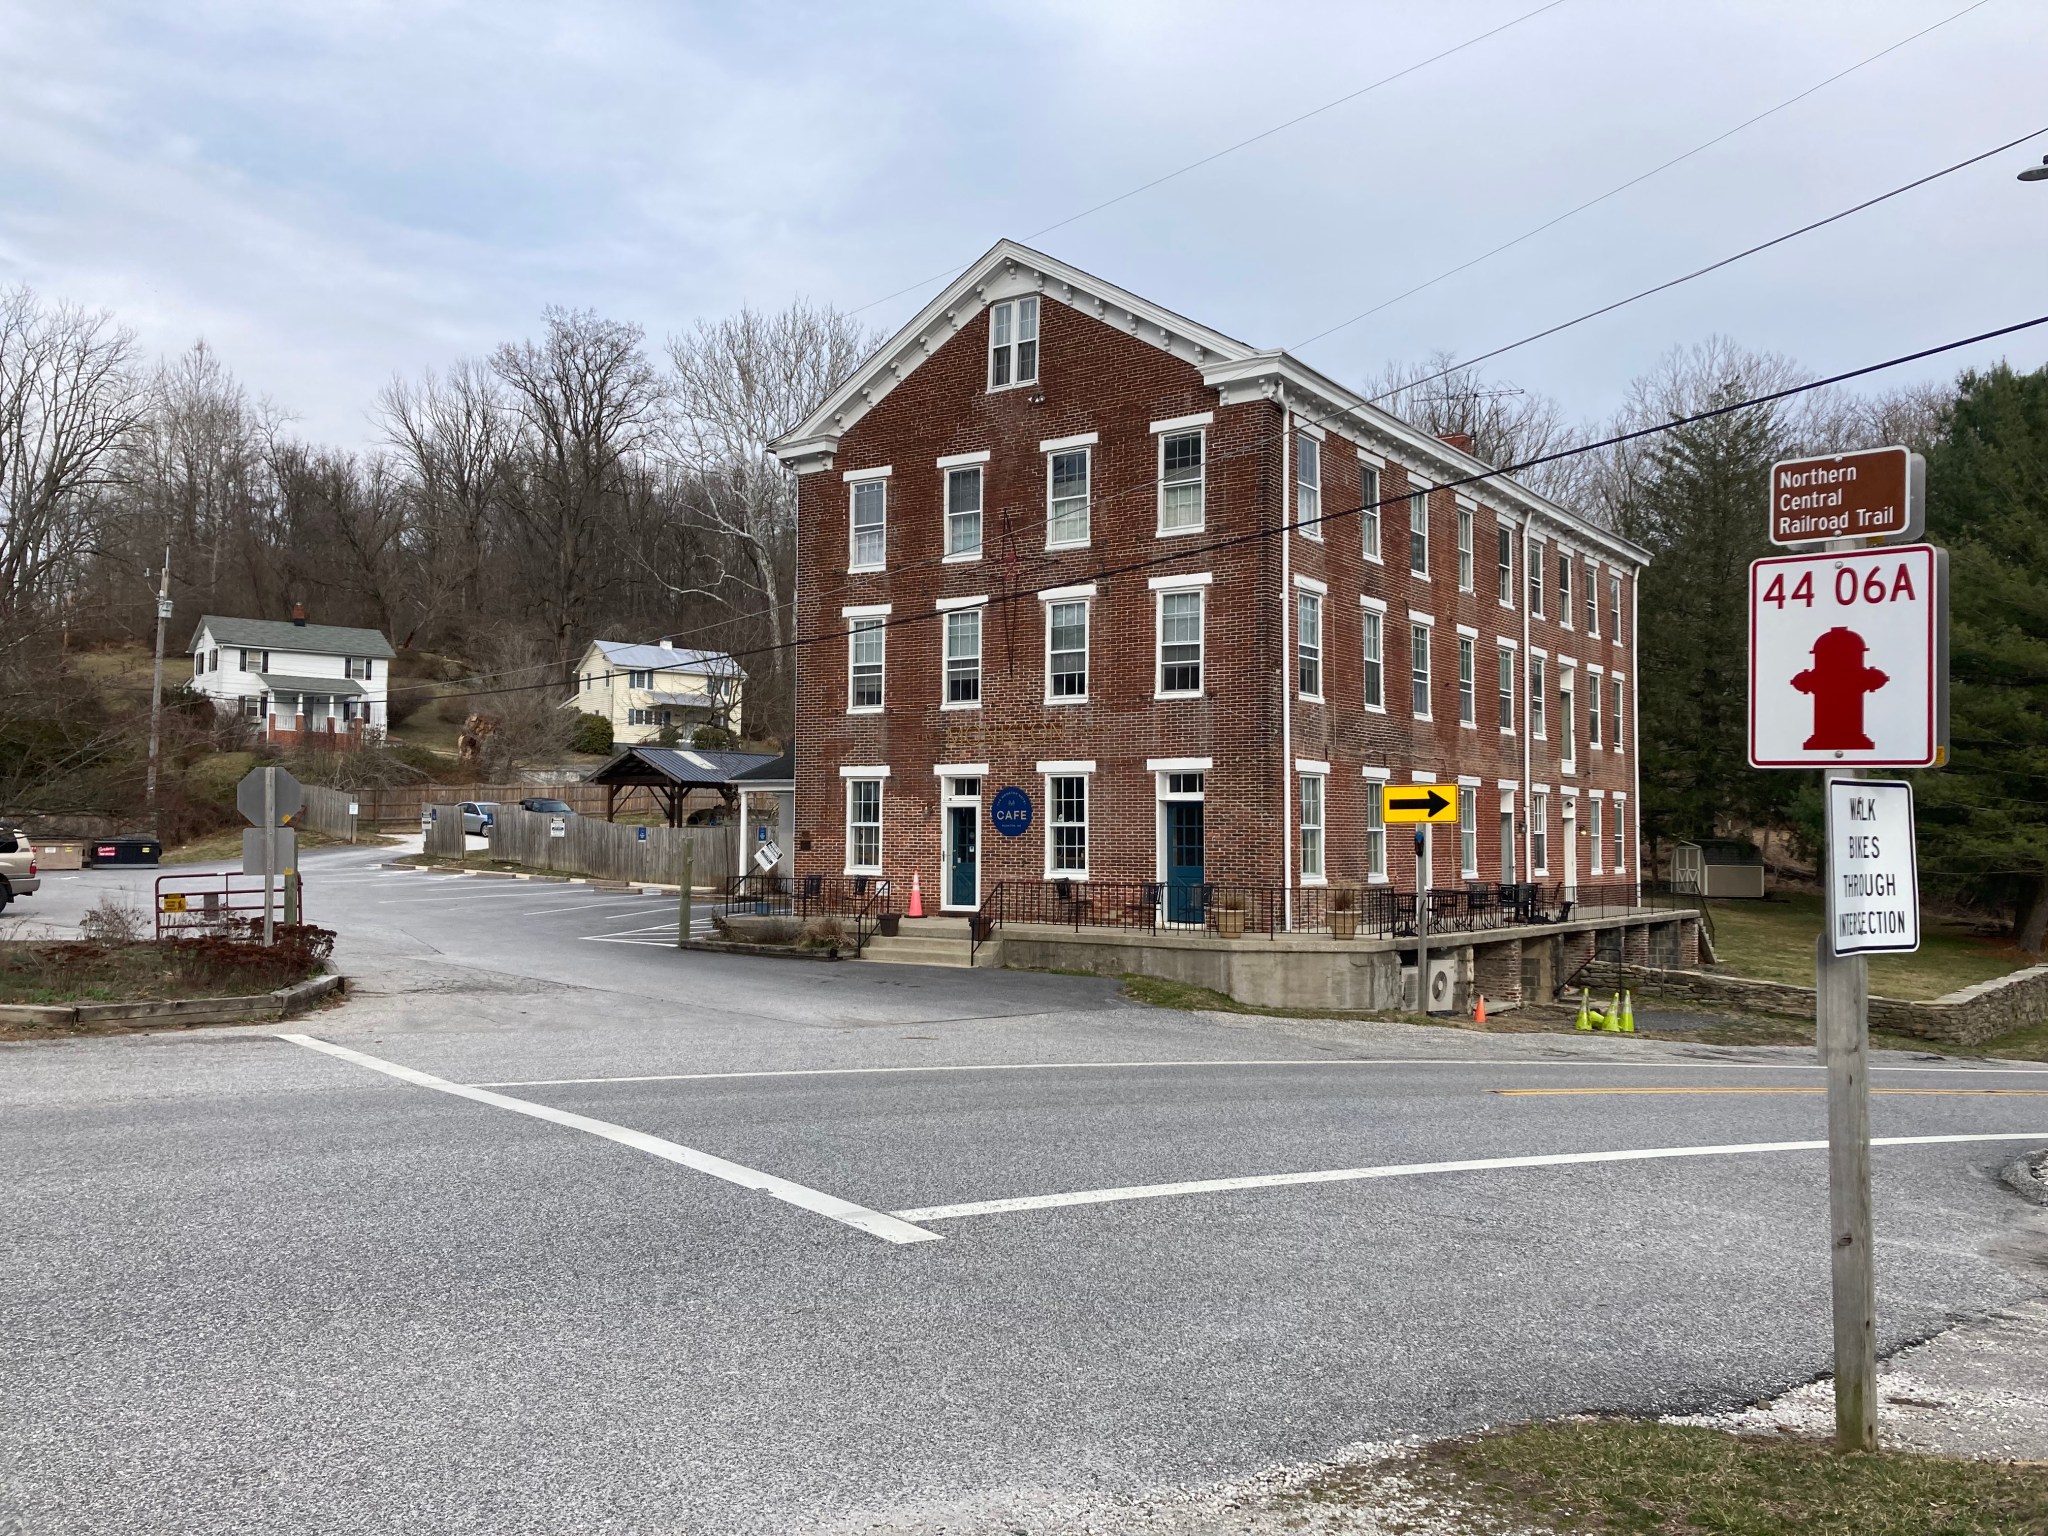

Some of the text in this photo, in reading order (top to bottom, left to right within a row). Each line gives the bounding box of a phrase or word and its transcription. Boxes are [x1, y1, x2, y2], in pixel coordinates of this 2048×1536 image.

[1780, 467, 1857, 488] Northern
[1780, 489, 1842, 512] Central
[1779, 506, 1894, 534] Railroad Trail
[1763, 563, 1916, 609] 44 06A
[946, 721, 1065, 746] MONKTON
[996, 810, 1027, 820] CAFE
[1850, 797, 1876, 821] WALK
[1849, 836, 1880, 859] BIKES
[1843, 874, 1896, 898] THROUGH
[1839, 911, 1905, 937] INTERSECTION
